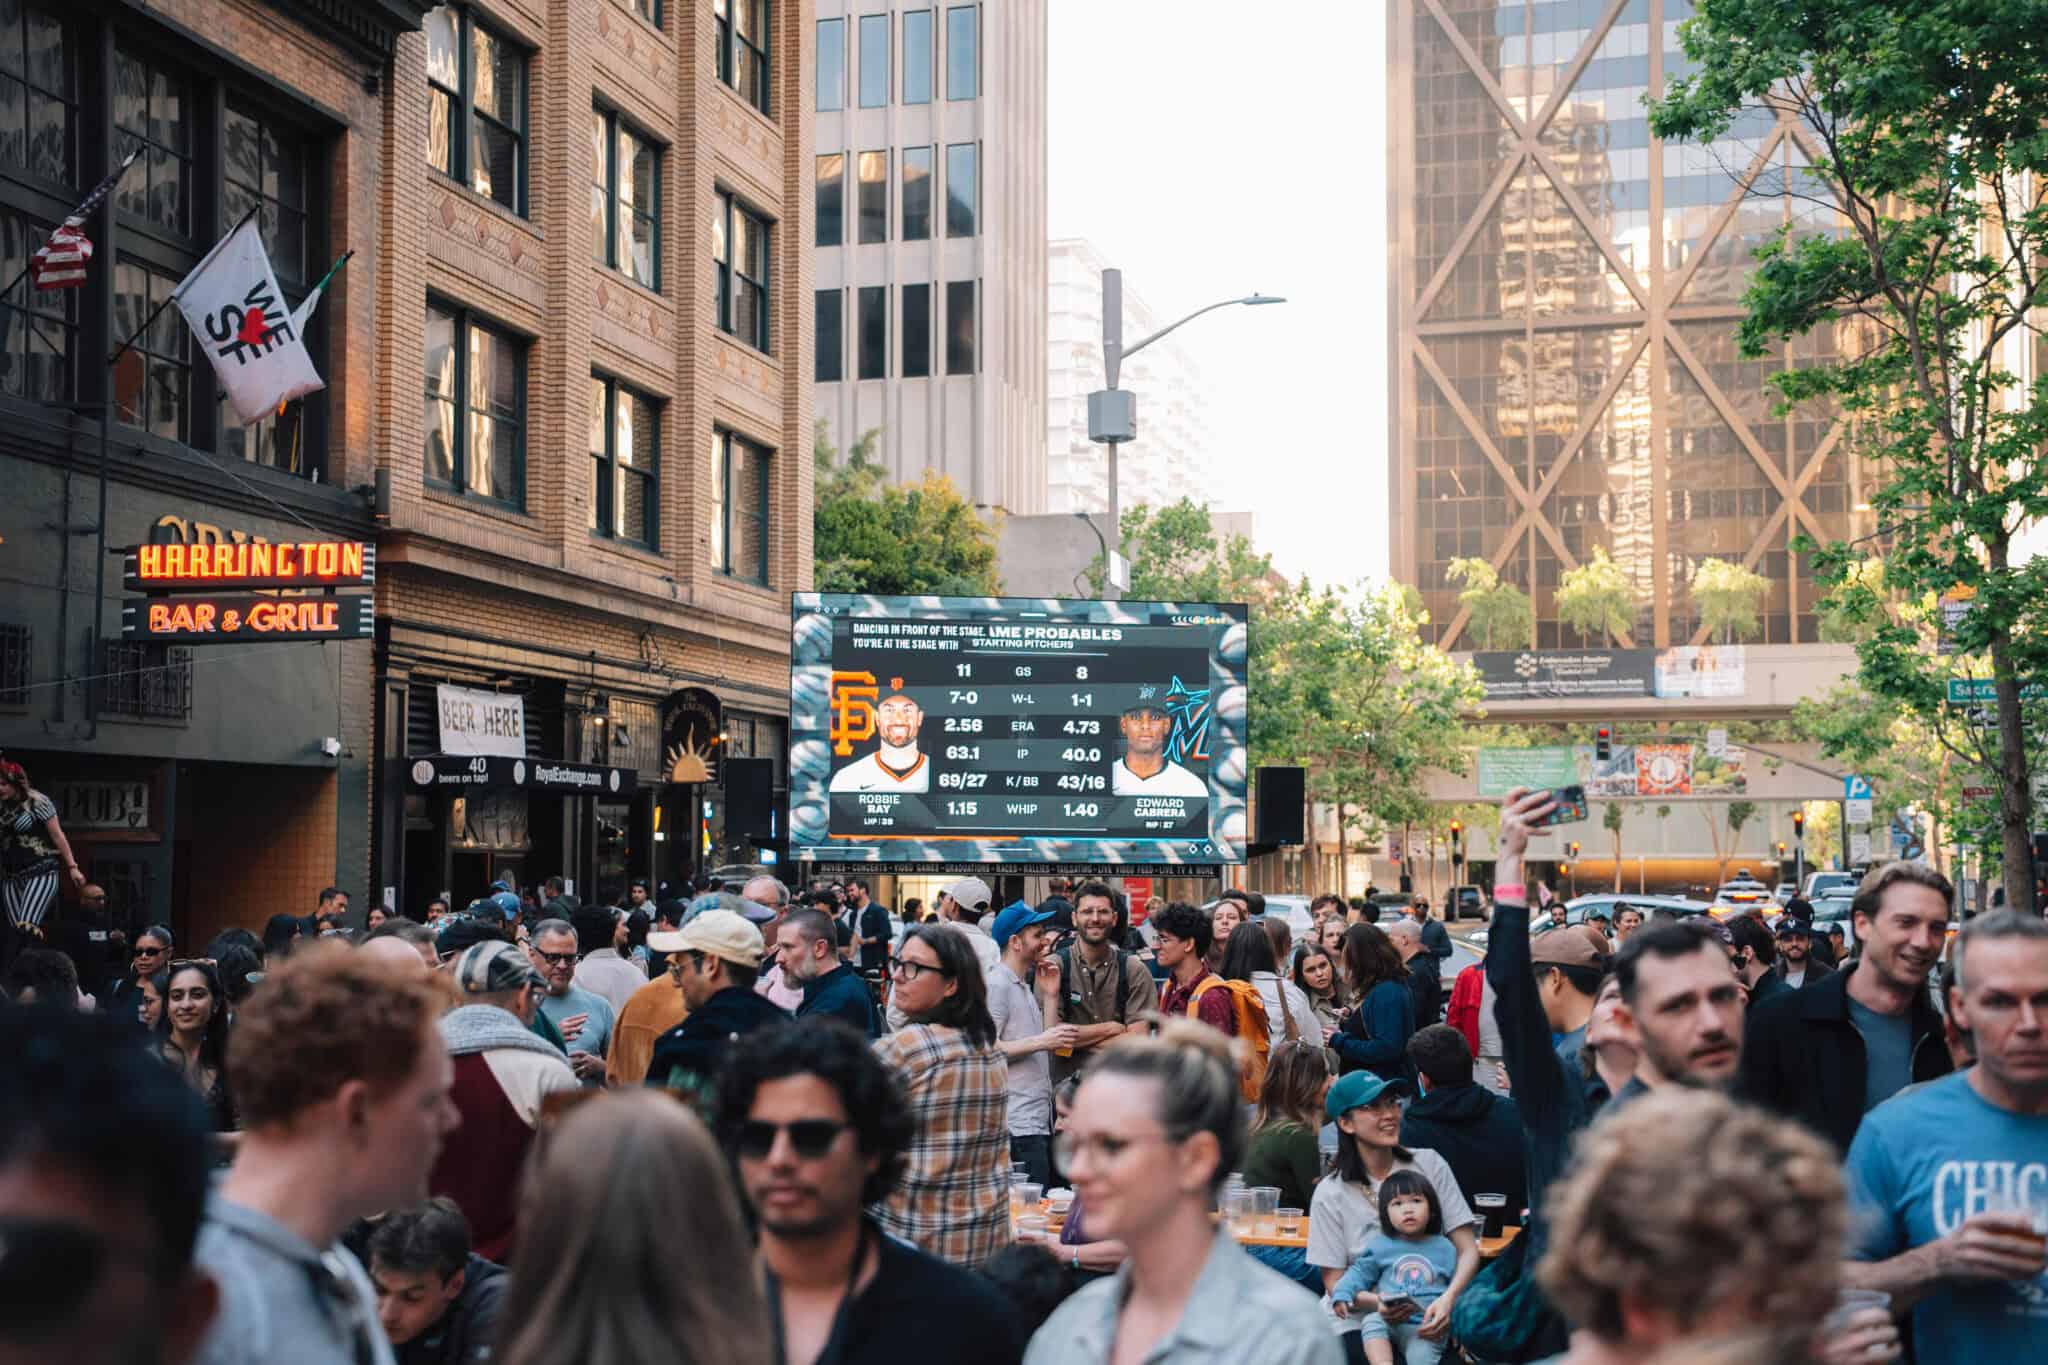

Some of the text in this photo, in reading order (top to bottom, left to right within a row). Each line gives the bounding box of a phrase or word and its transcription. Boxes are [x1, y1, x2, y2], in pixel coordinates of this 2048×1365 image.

[244, 279, 294, 353] WE
[205, 304, 261, 365] SF
[139, 543, 364, 578] HARRINGTON
[150, 602, 339, 633] BAR & GRILL
[853, 623, 890, 634] DANCING
[891, 624, 901, 634] IN
[902, 625, 928, 635] FRONT
[930, 625, 941, 635] OF
[943, 626, 958, 636] THE
[1024, 628, 1123, 641] PROBABLES
[853, 638, 959, 651] YOU'RE AT THE STAGE WITH
[972, 638, 1074, 649] STARTING PITCHERS
[956, 664, 1088, 680] 11 GS 8
[949, 691, 1093, 707] 7-0 W-L 1-1
[442, 699, 520, 738] BEER HERE
[944, 719, 1100, 734] 2.56 ERA 4.73
[946, 746, 1101, 762] 63.1 IP 40.0
[468, 757, 487, 773] 40
[438, 772, 489, 785] beers on tap!
[535, 764, 602, 788] RoyalExchange.com
[939, 772, 987, 790] 69/27
[1057, 774, 1106, 792] 43/16
[858, 794, 901, 804] ROBBIE
[1136, 798, 1185, 808] EDWARD
[866, 804, 891, 814] RAY
[947, 802, 1099, 817] 1.15 WHIP 1.40
[1134, 808, 1186, 817] CABRERA
[851, 863, 888, 873] CONCERTS
